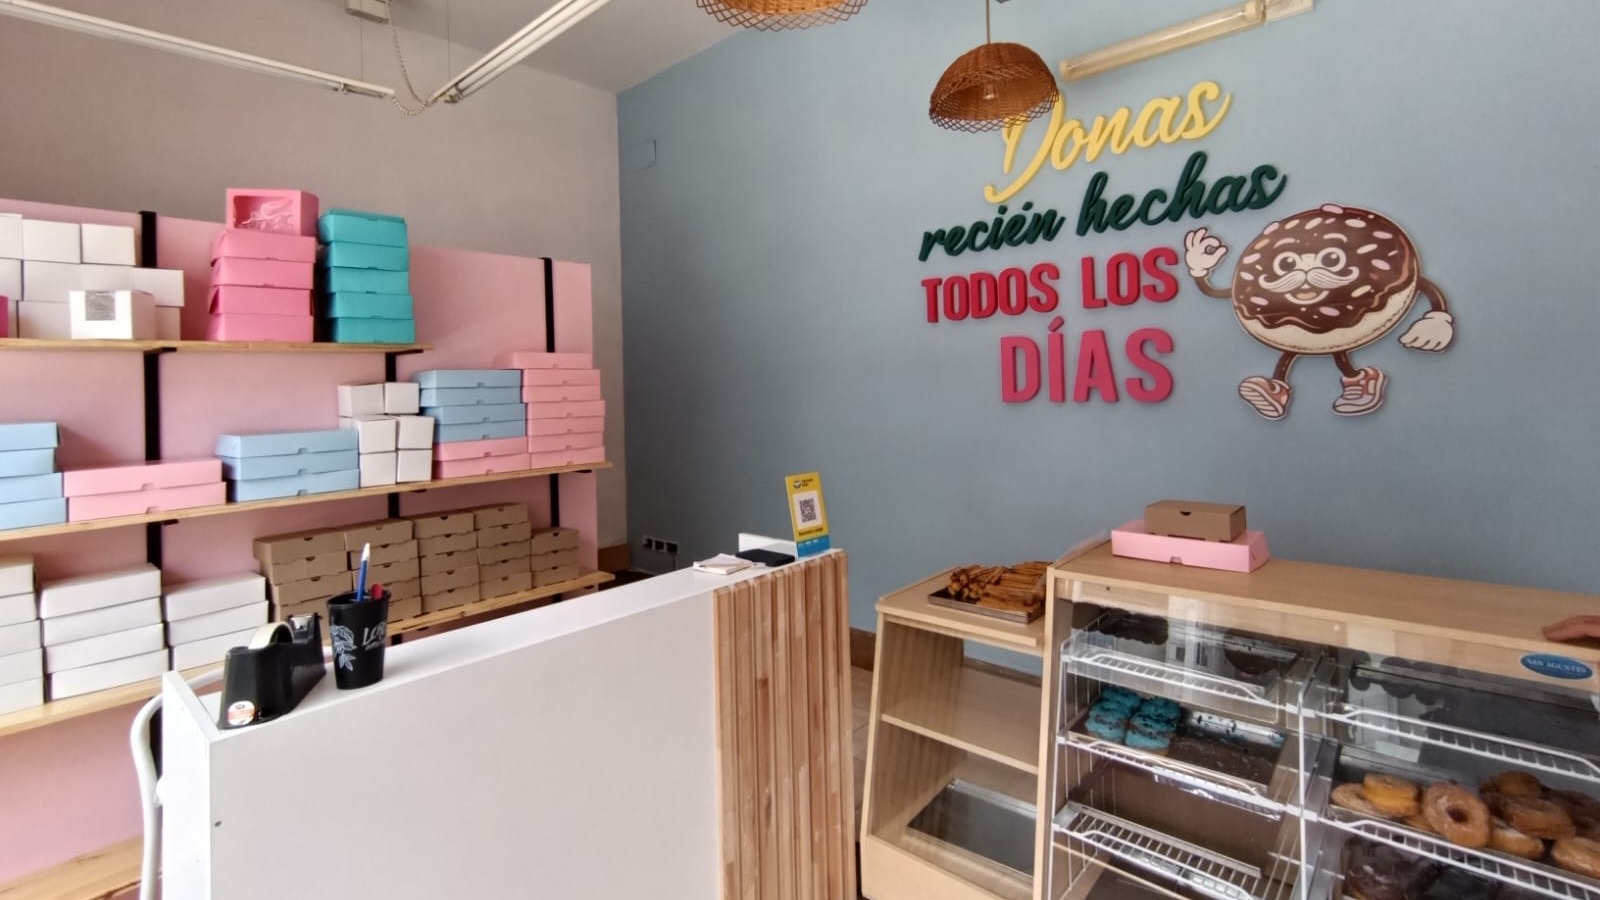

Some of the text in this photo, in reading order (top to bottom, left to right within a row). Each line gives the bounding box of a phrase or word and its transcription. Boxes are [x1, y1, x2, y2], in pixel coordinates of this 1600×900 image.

[984, 81, 1231, 203] Donas
[918, 151, 1288, 261] recién hechas
[921, 246, 1180, 323] TODOS LOS
[1000, 316, 1175, 403] DÍAS
